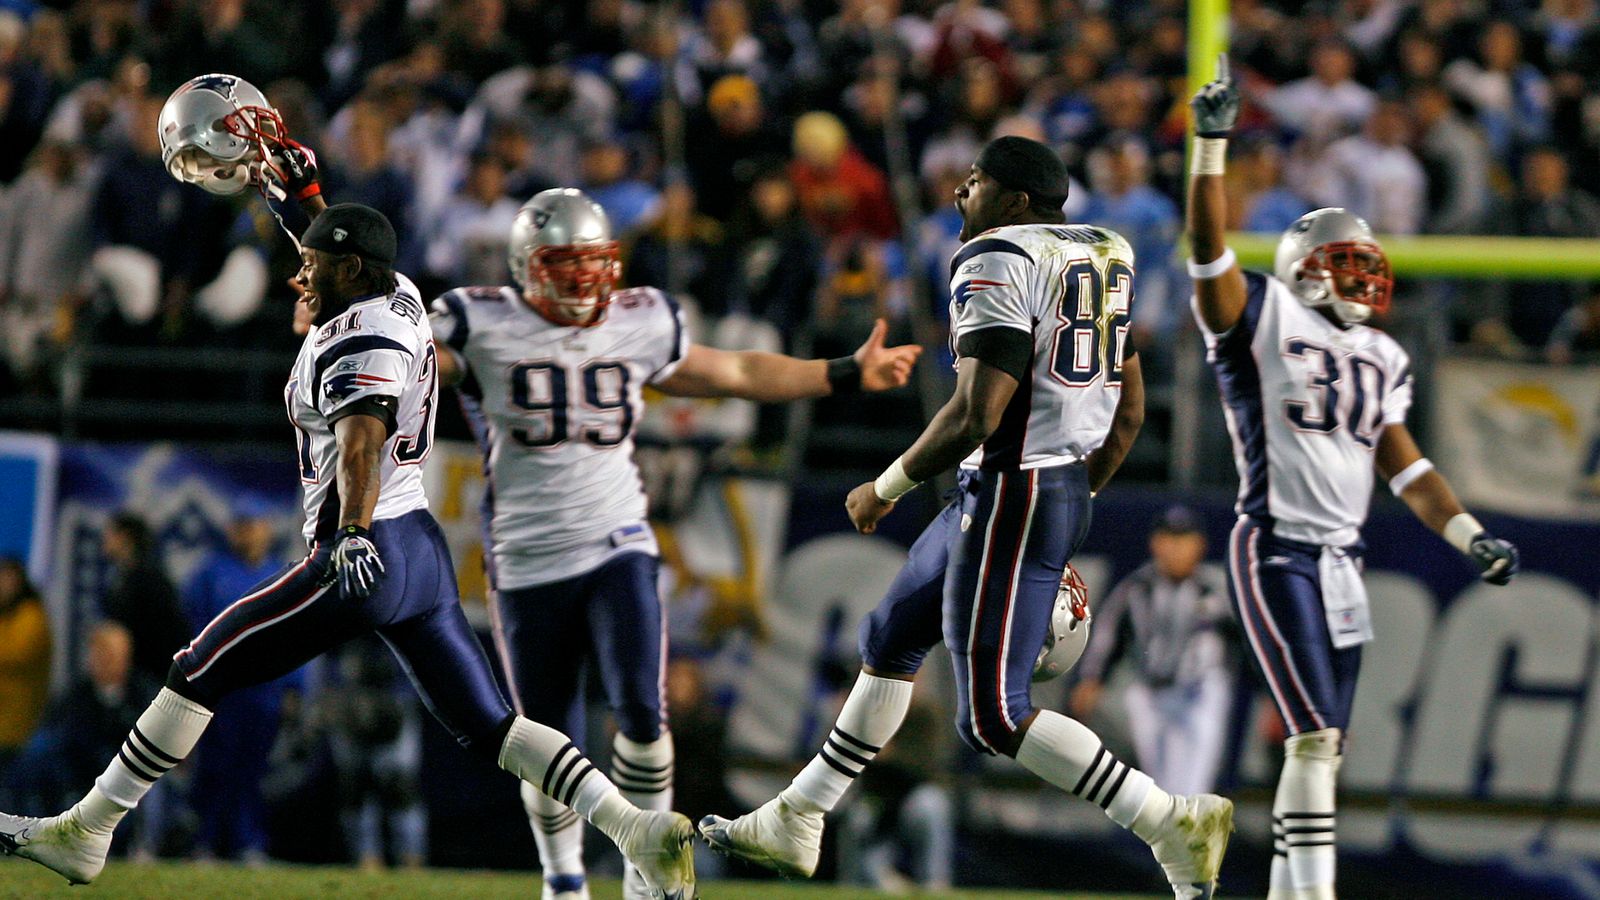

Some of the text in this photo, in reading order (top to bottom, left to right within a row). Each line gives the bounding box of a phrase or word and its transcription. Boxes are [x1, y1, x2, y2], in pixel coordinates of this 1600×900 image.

[1050, 258, 1135, 388] 82
[507, 356, 636, 451] 99
[1280, 335, 1386, 452] 30
